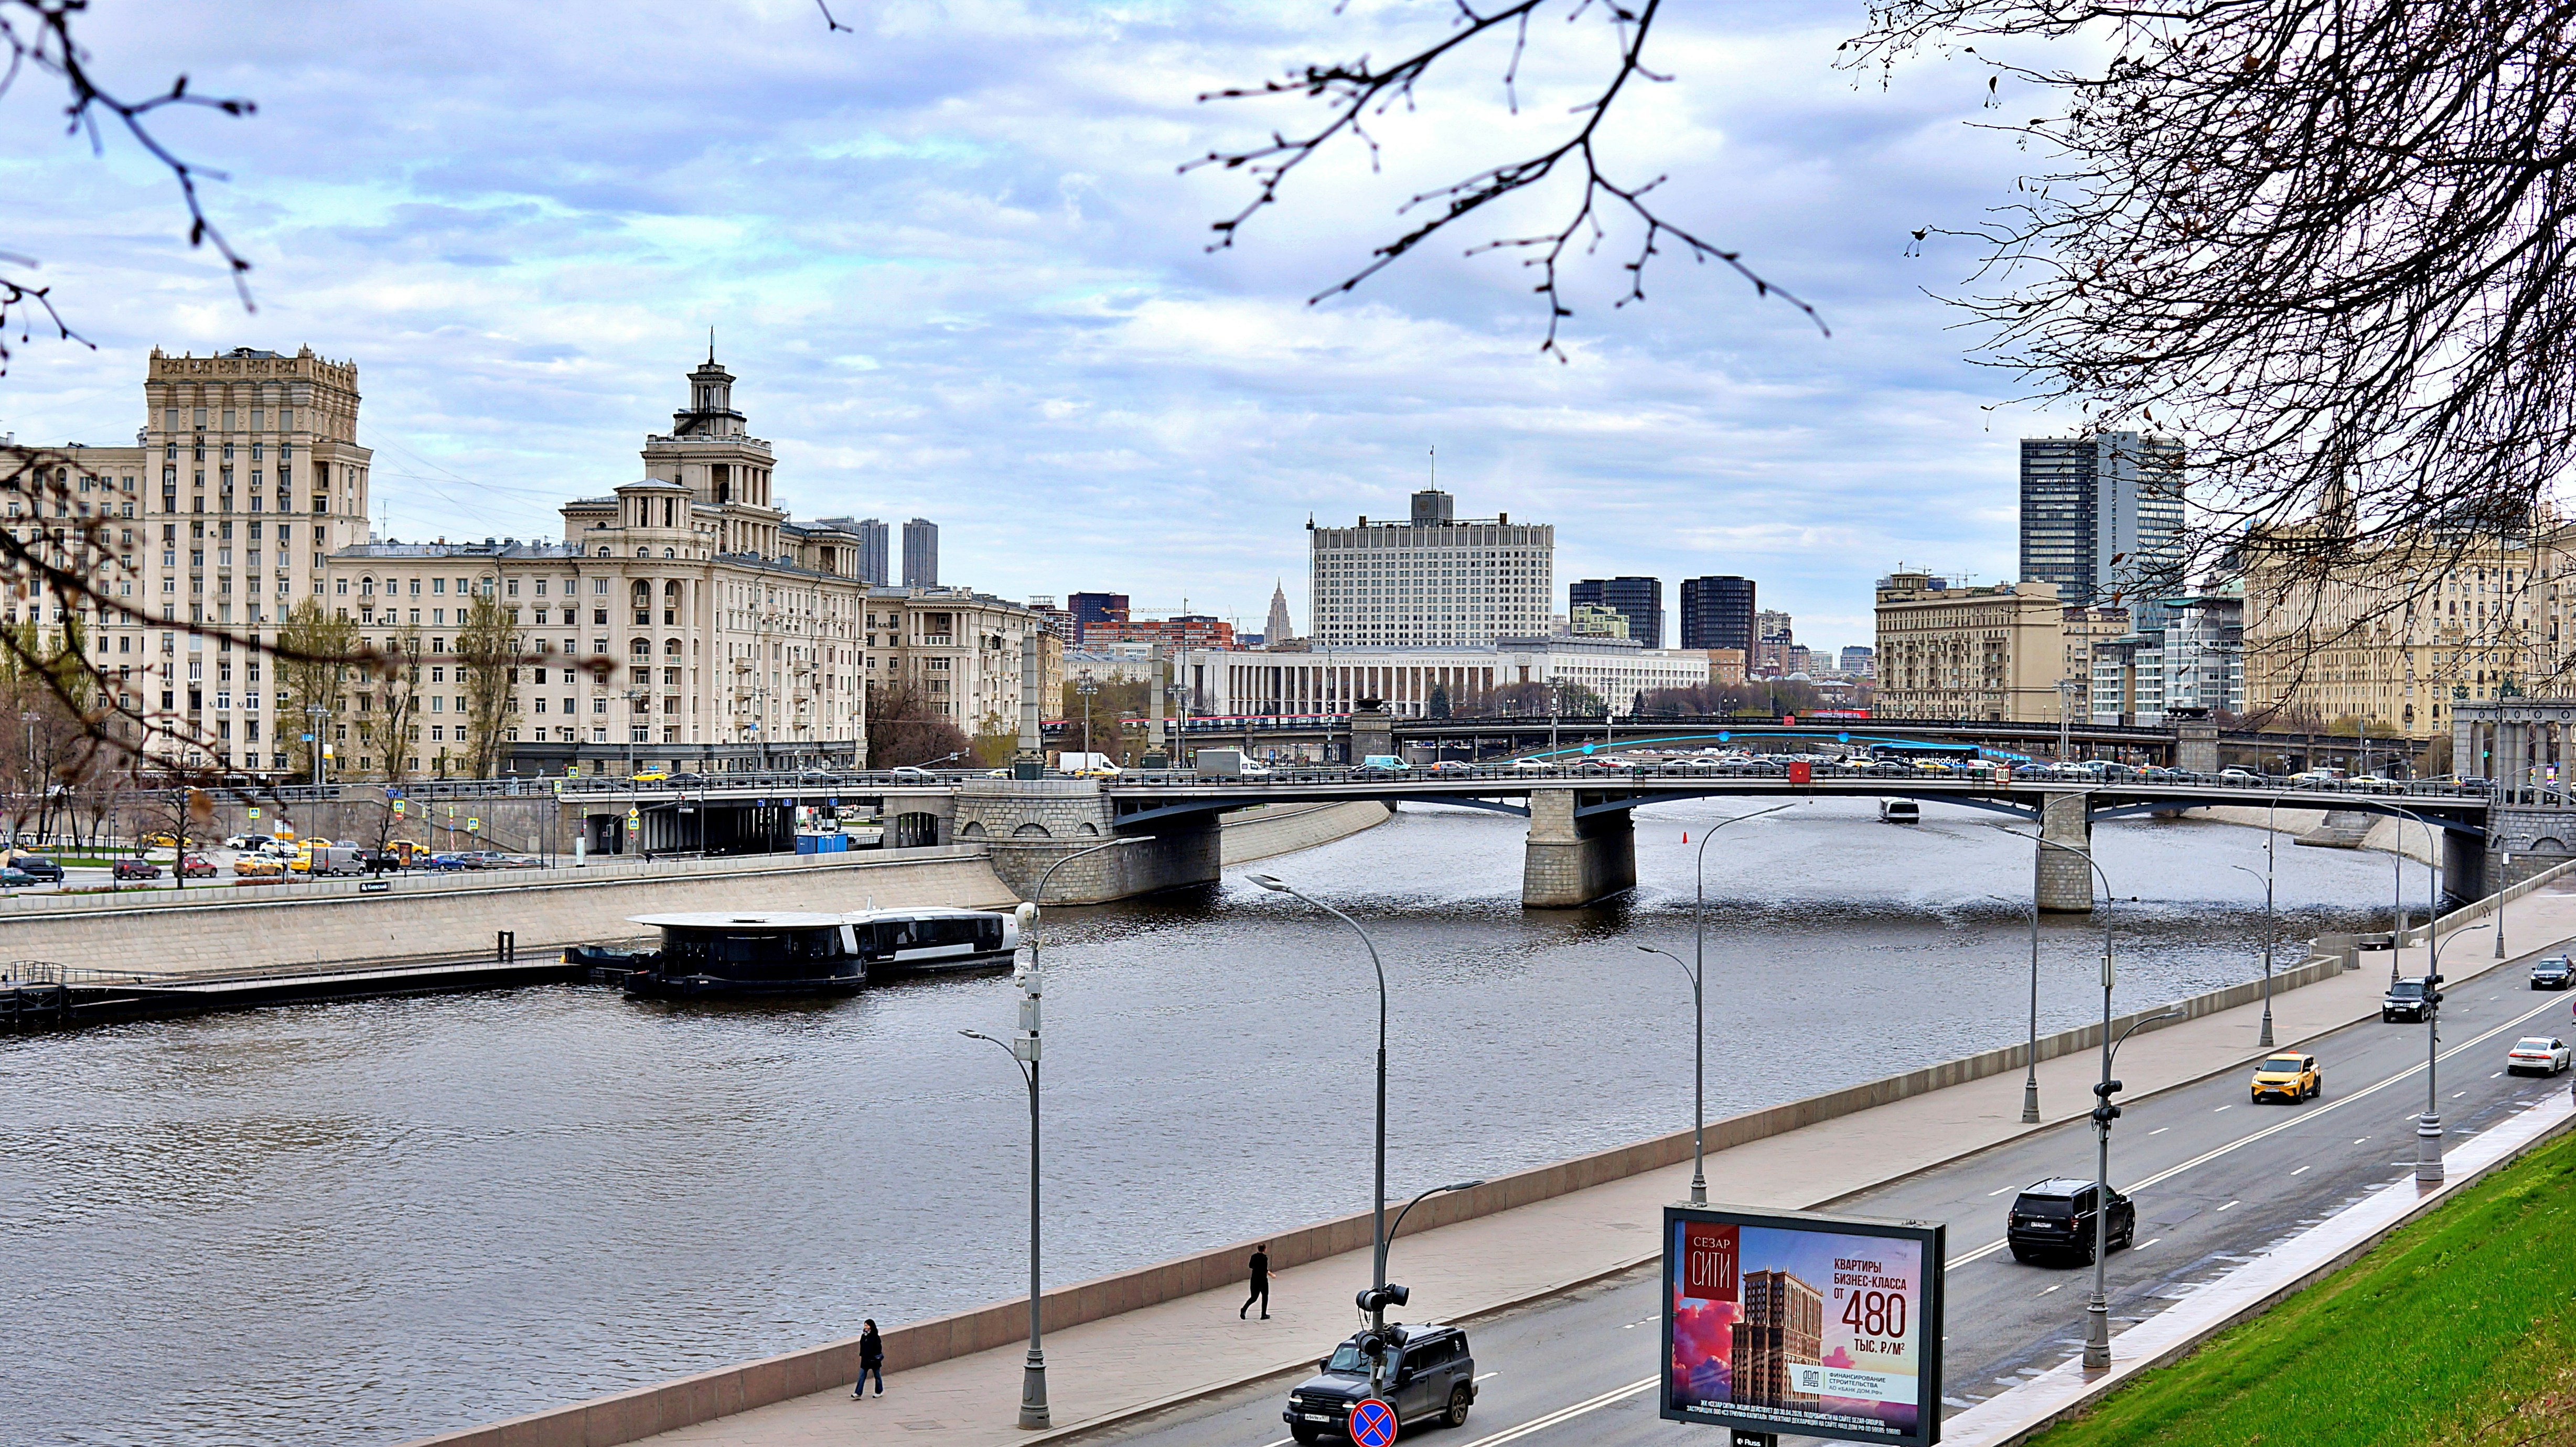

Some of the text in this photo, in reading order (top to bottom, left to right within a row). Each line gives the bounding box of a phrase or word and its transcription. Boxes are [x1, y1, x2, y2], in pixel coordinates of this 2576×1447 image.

[1998, 771, 2009, 779] 10.0
[1693, 1236, 1730, 1249] СЕЗАР
[1692, 1251, 1730, 1288] СИТИ
[1834, 1258, 1882, 1273] КВАРТИРЫ
[1834, 1273, 1907, 1290] БИЗНЕС-КЛАССА
[1834, 1288, 1906, 1338] ОТ 480
[1854, 1338, 1877, 1353] ТЫС.
[1803, 1370, 1819, 1380] ДОМ
[1829, 1372, 1886, 1383] ФИНАНСИРОВАНИЕ
[1829, 1378, 1879, 1388] СТРОИТЕЛЬСТВА
[1751, 1405, 1773, 1413] ДЕЙСТВУЕТ
[1804, 1411, 1832, 1420] ПОДРОБНОСТИ
[1768, 1414, 1791, 1423] ПРОЕКТНАЯ
[1791, 1417, 1818, 1426] ДЕКЛАРАЦИЯ
[1744, 1439, 1761, 1447] Russ
